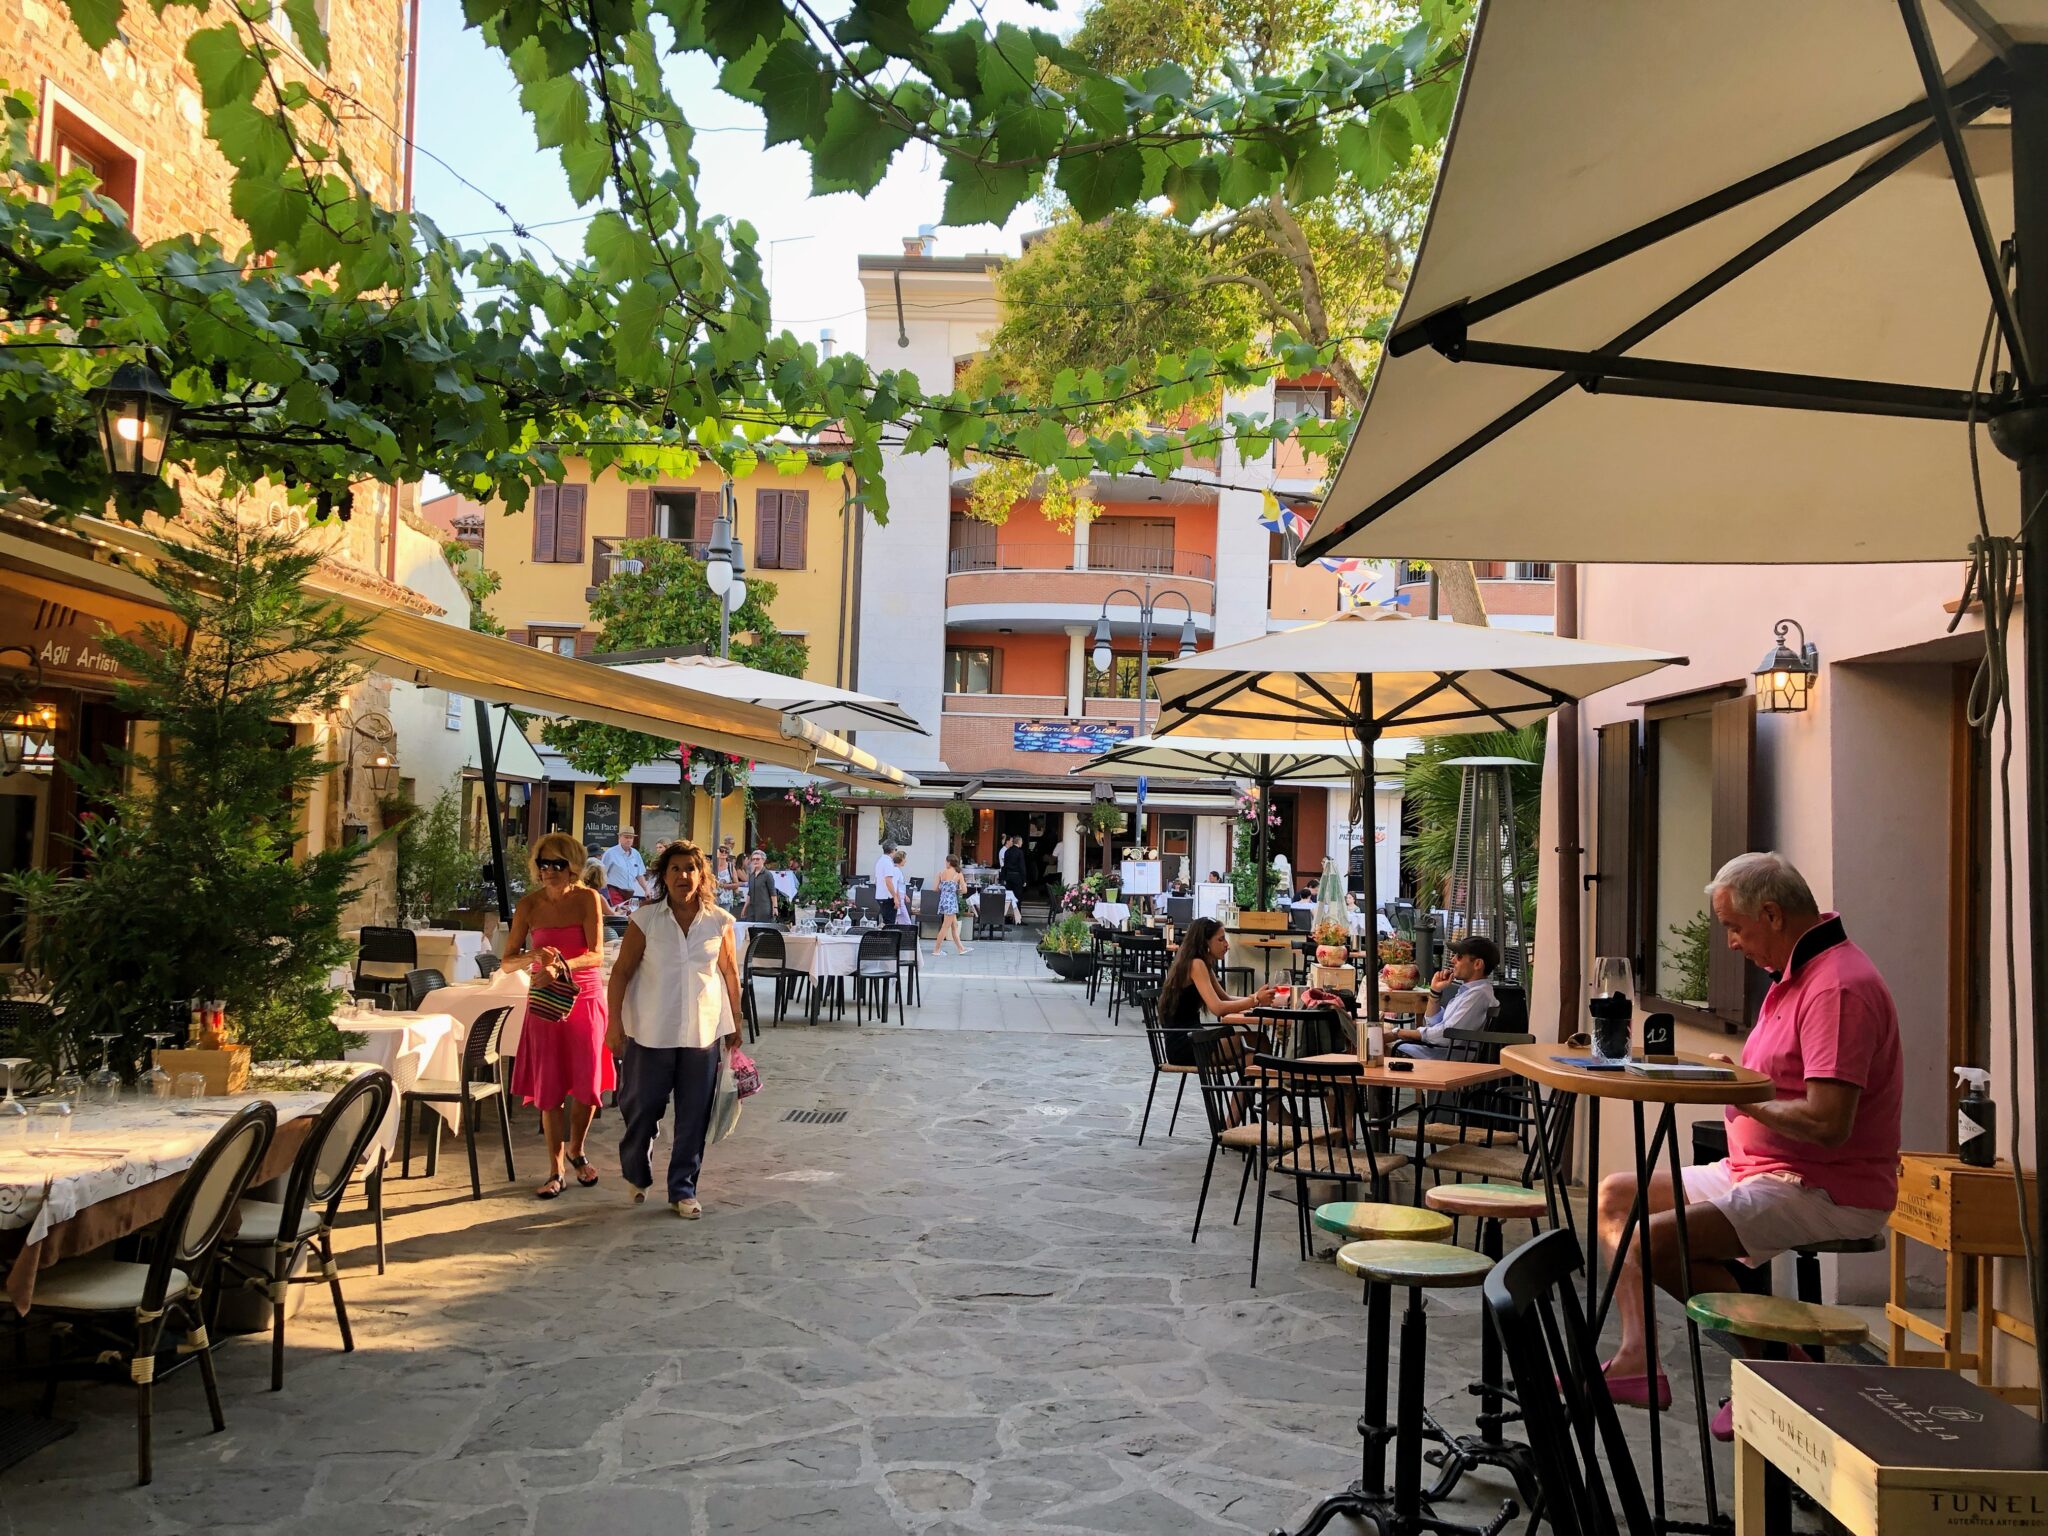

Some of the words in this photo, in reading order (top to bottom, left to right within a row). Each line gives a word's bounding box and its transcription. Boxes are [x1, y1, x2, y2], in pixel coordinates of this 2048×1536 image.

[40, 640, 70, 665] Agli
[76, 647, 118, 673] Artisti
[585, 822, 599, 831] Alla
[601, 823, 618, 831] Pace
[1646, 1028, 1667, 1044] 12
[1865, 1387, 1960, 1440] TUNELLA
[1770, 1409, 1827, 1468] TUNELLA
[1928, 1493, 2046, 1514] TUNEL
[1947, 1517, 1994, 1526] AUTENTICA
